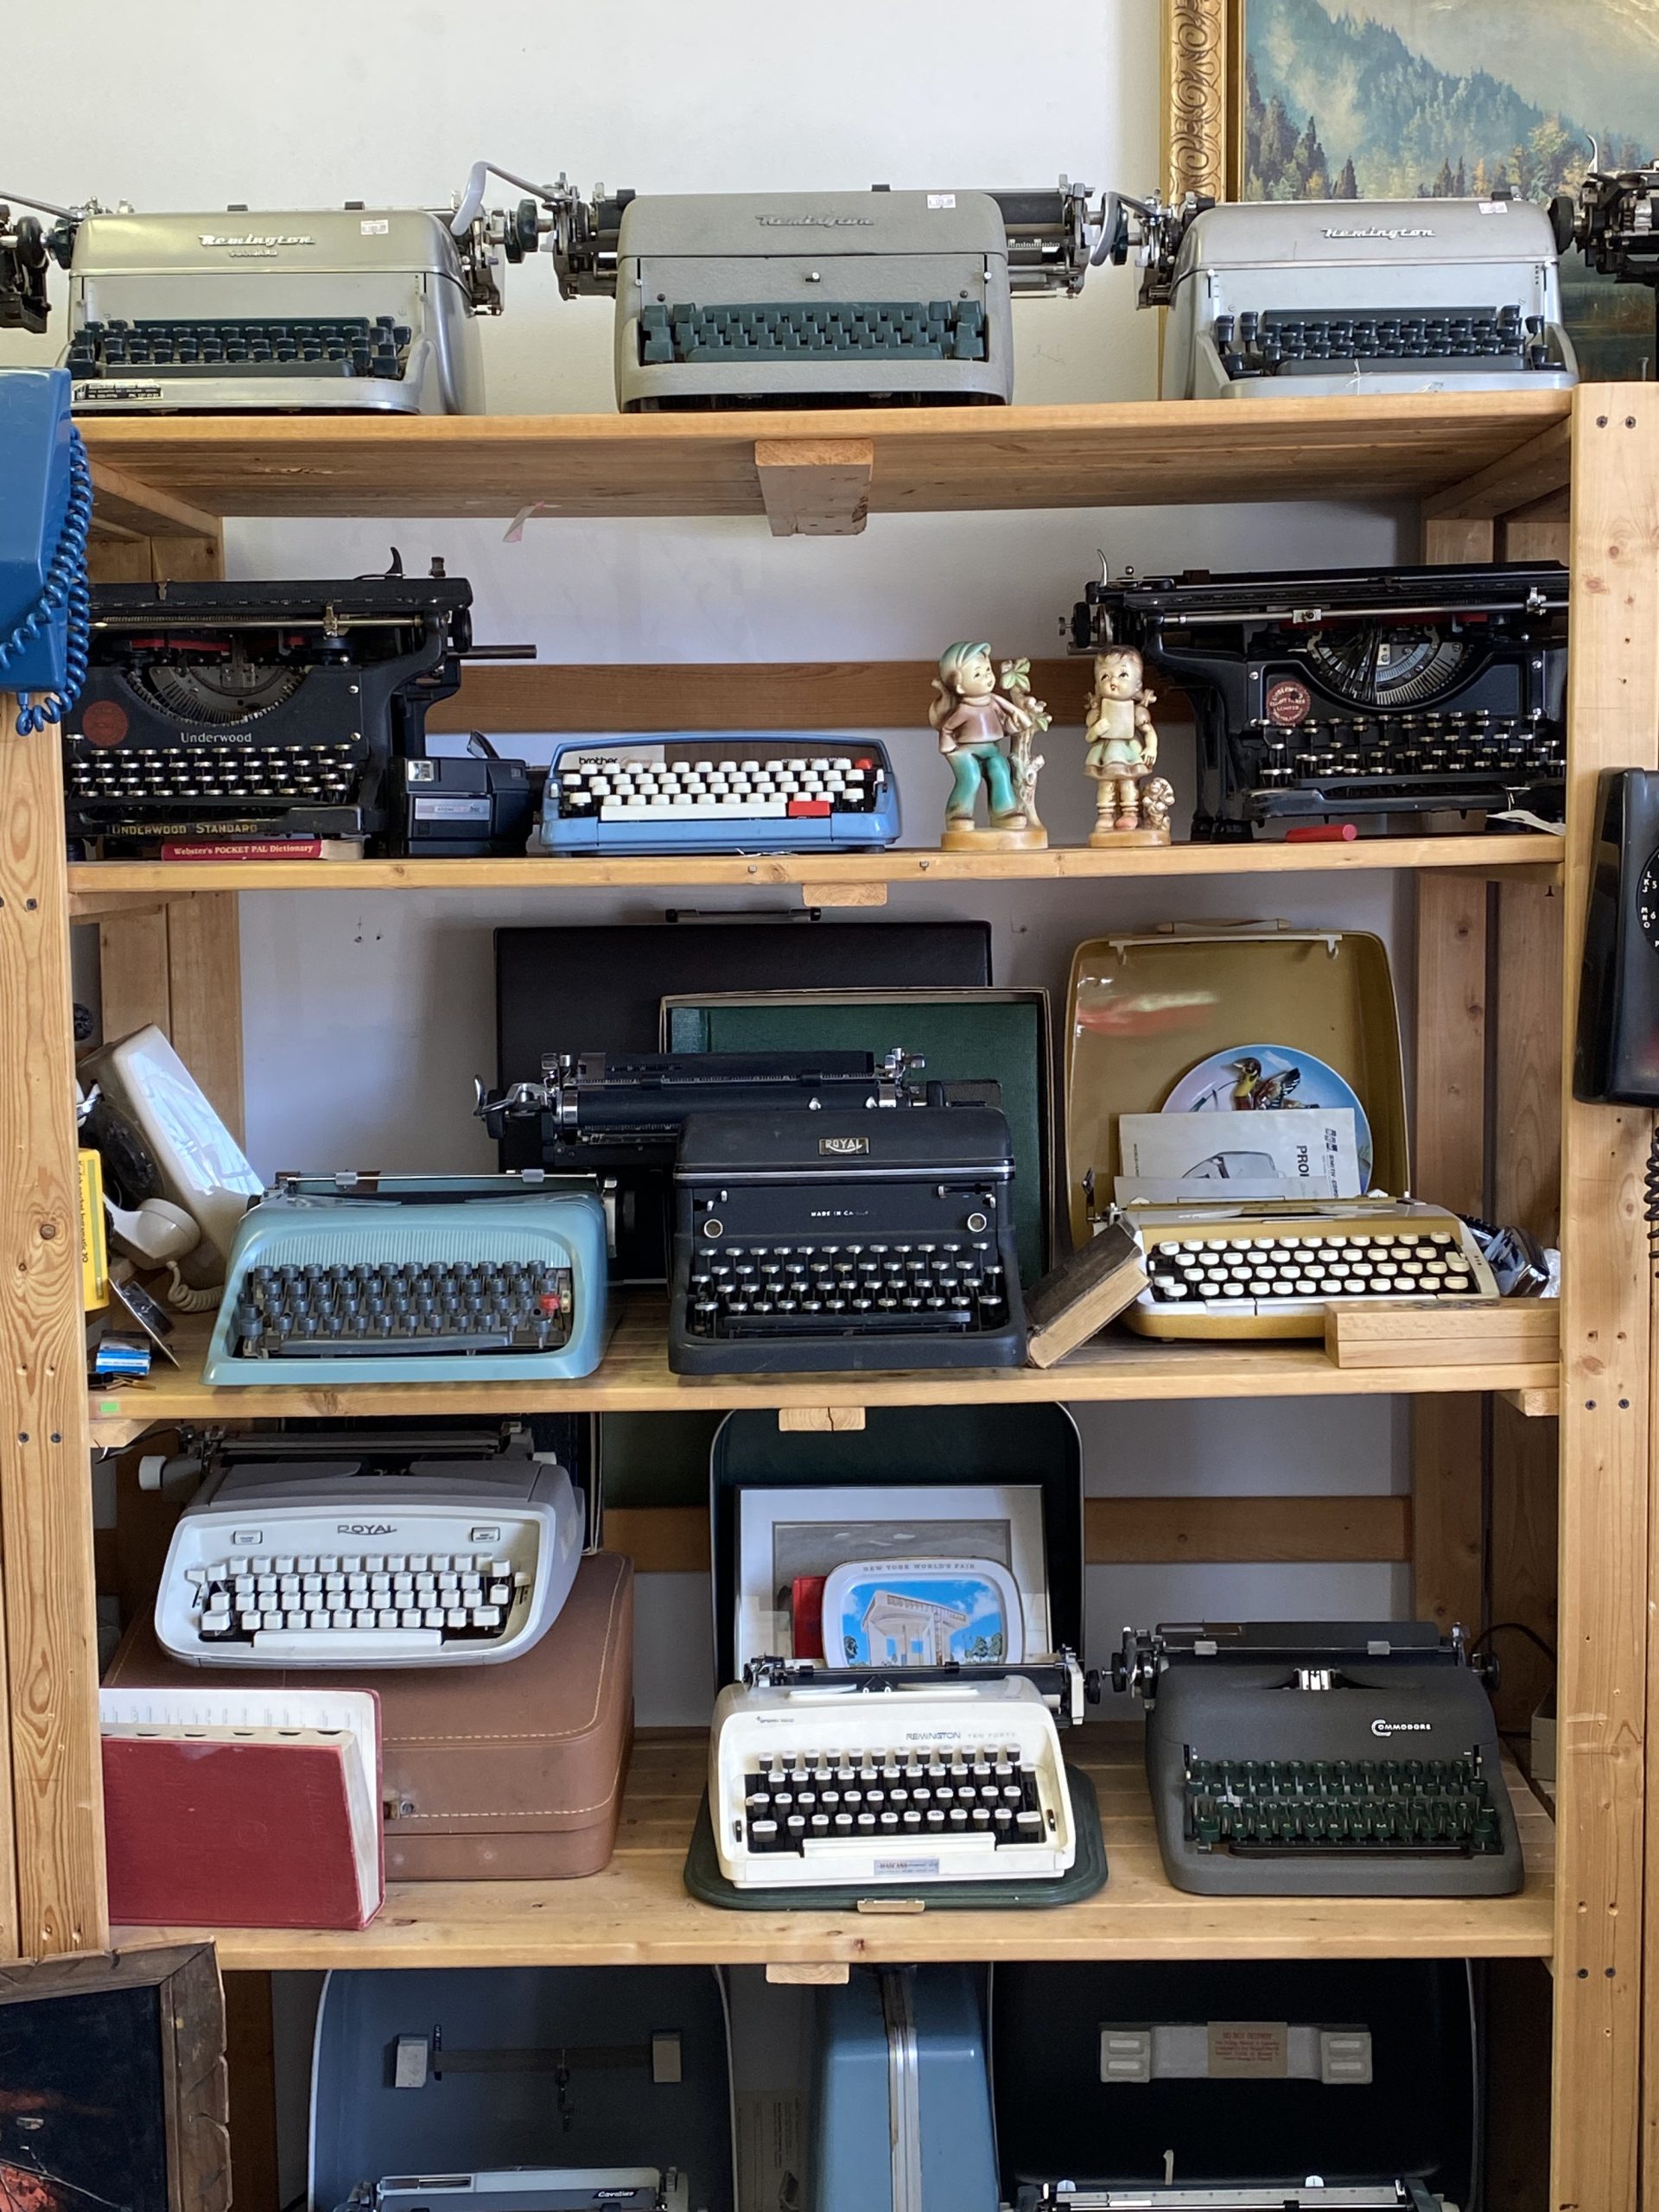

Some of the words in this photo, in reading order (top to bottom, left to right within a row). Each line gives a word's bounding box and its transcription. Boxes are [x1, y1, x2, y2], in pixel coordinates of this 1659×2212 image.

[755, 215, 874, 228] Remington
[1321, 226, 1435, 240] Remington
[198, 233, 315, 247] Remington
[181, 732, 253, 743] Underwood
[578, 756, 619, 766] brother
[111, 824, 187, 836] UNDERWOOD
[195, 823, 258, 834] STANDARD
[174, 846, 213, 855] Webster's
[251, 844, 268, 854] PAL
[270, 843, 315, 853] Dictionary
[825, 1139, 863, 1153] ROYAL
[337, 1524, 397, 1535] ROYAL
[1371, 1719, 1431, 1737] COMMODORE
[906, 1732, 962, 1740] REMINGTON
